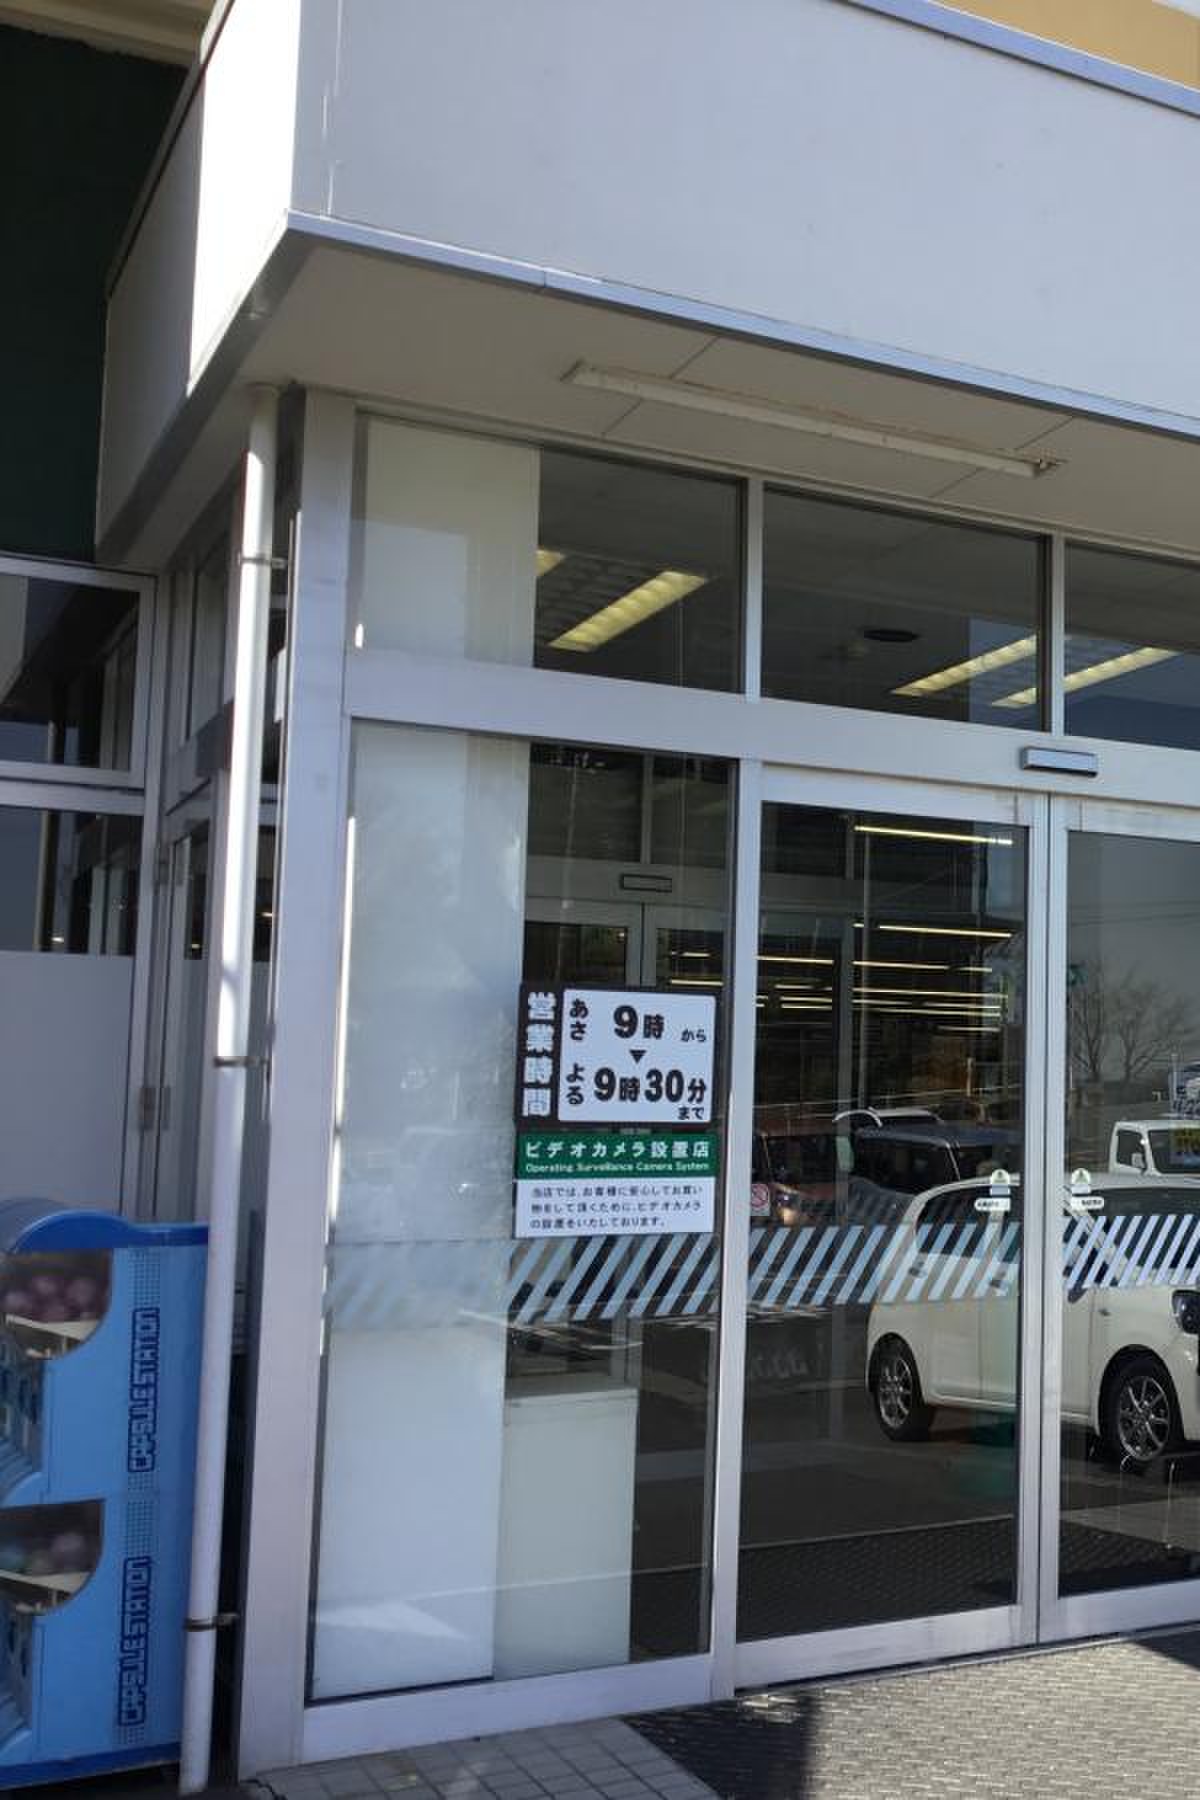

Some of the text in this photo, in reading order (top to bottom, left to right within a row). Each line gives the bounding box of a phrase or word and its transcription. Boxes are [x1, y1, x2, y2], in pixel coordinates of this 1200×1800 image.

[569, 998, 707, 1043] あさ 9時 から
[522, 991, 556, 1117] 営業時間
[565, 1063, 707, 1105] よる 9時30分
[678, 1106, 705, 1121] まで
[525, 1141, 710, 1159] ビデオカメラ設置店
[525, 1160, 710, 1174] Operating Surveillance Camera System
